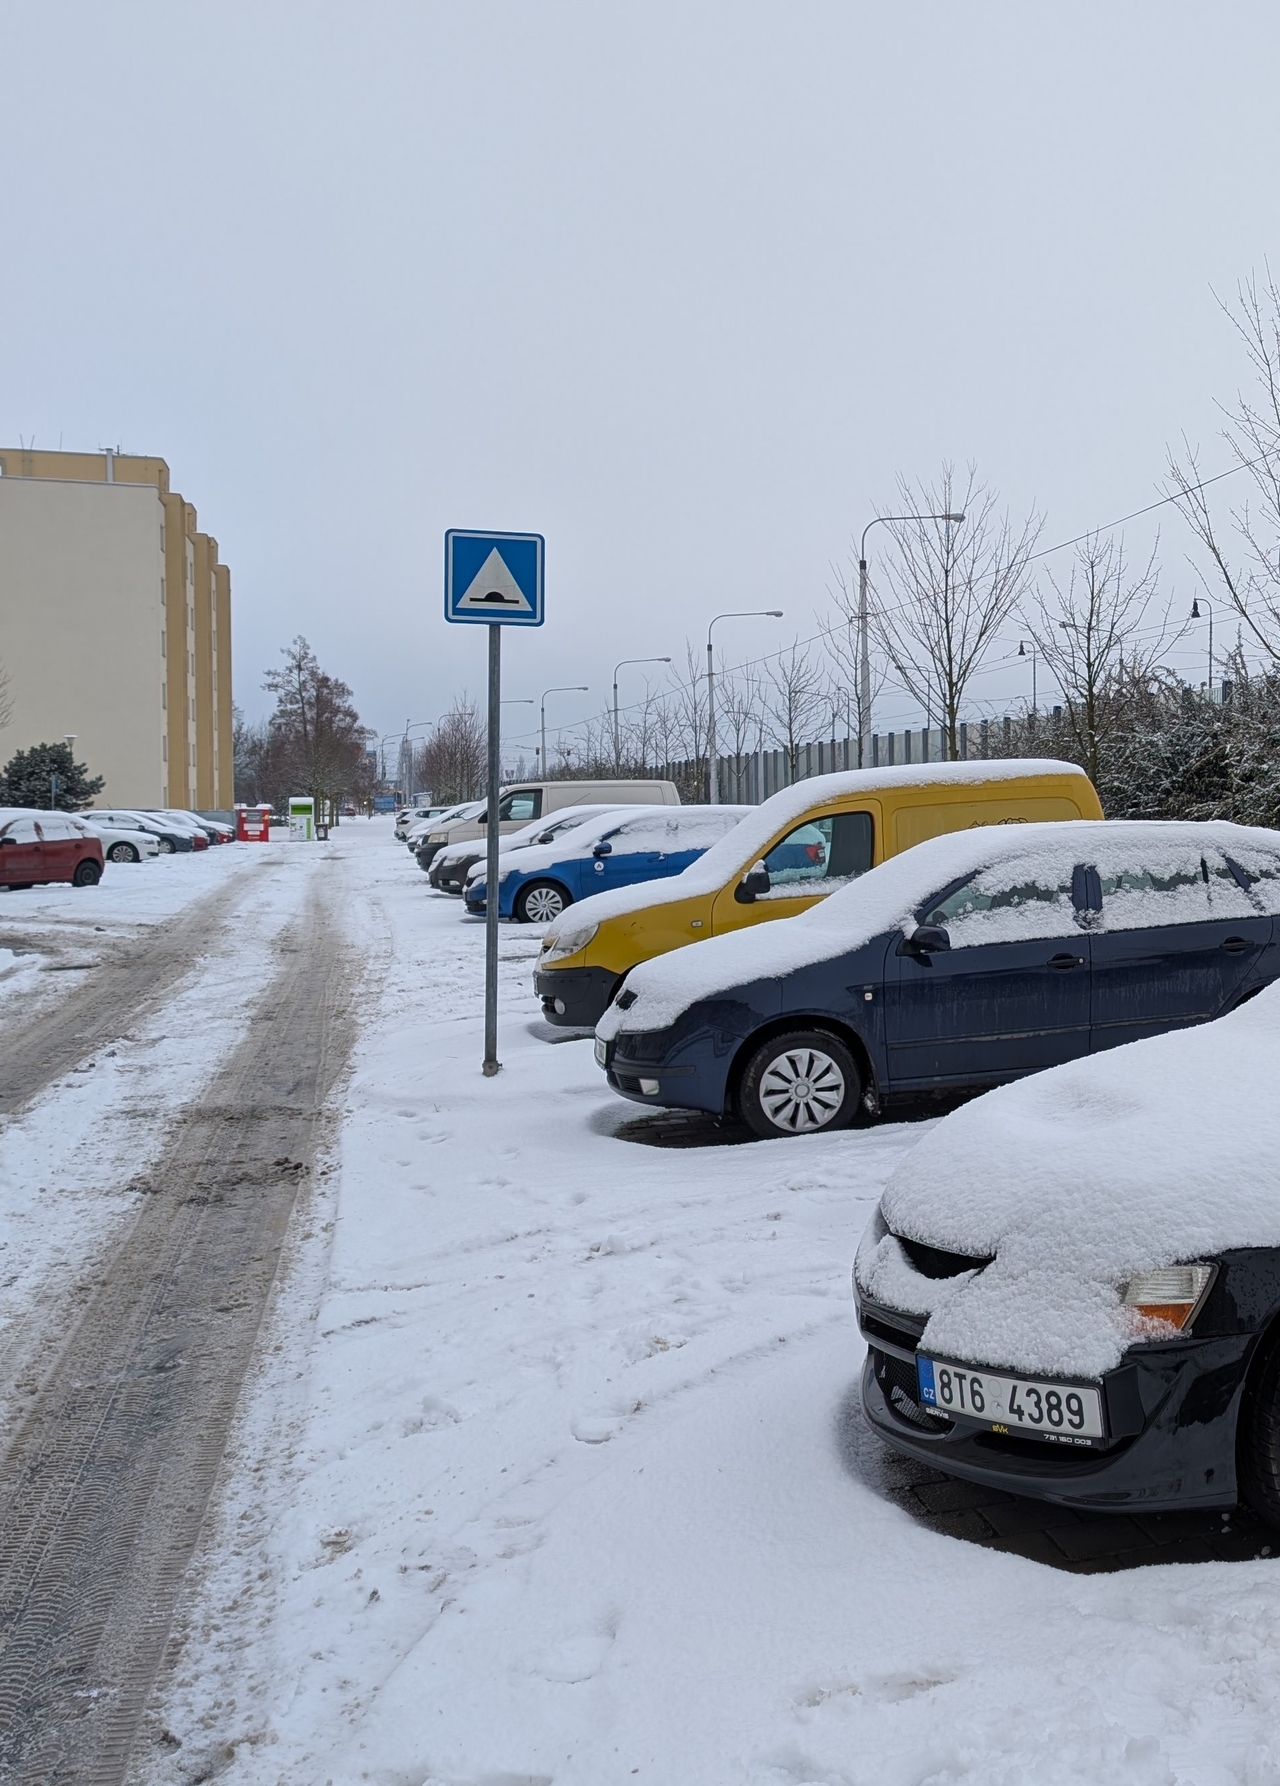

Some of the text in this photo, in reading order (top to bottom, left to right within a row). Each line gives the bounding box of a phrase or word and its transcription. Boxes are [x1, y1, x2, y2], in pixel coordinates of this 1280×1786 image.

[923, 1387, 935, 1400] CZ
[939, 1369, 1085, 1430] 8T6 4389
[1074, 1438, 1092, 1446] 003
